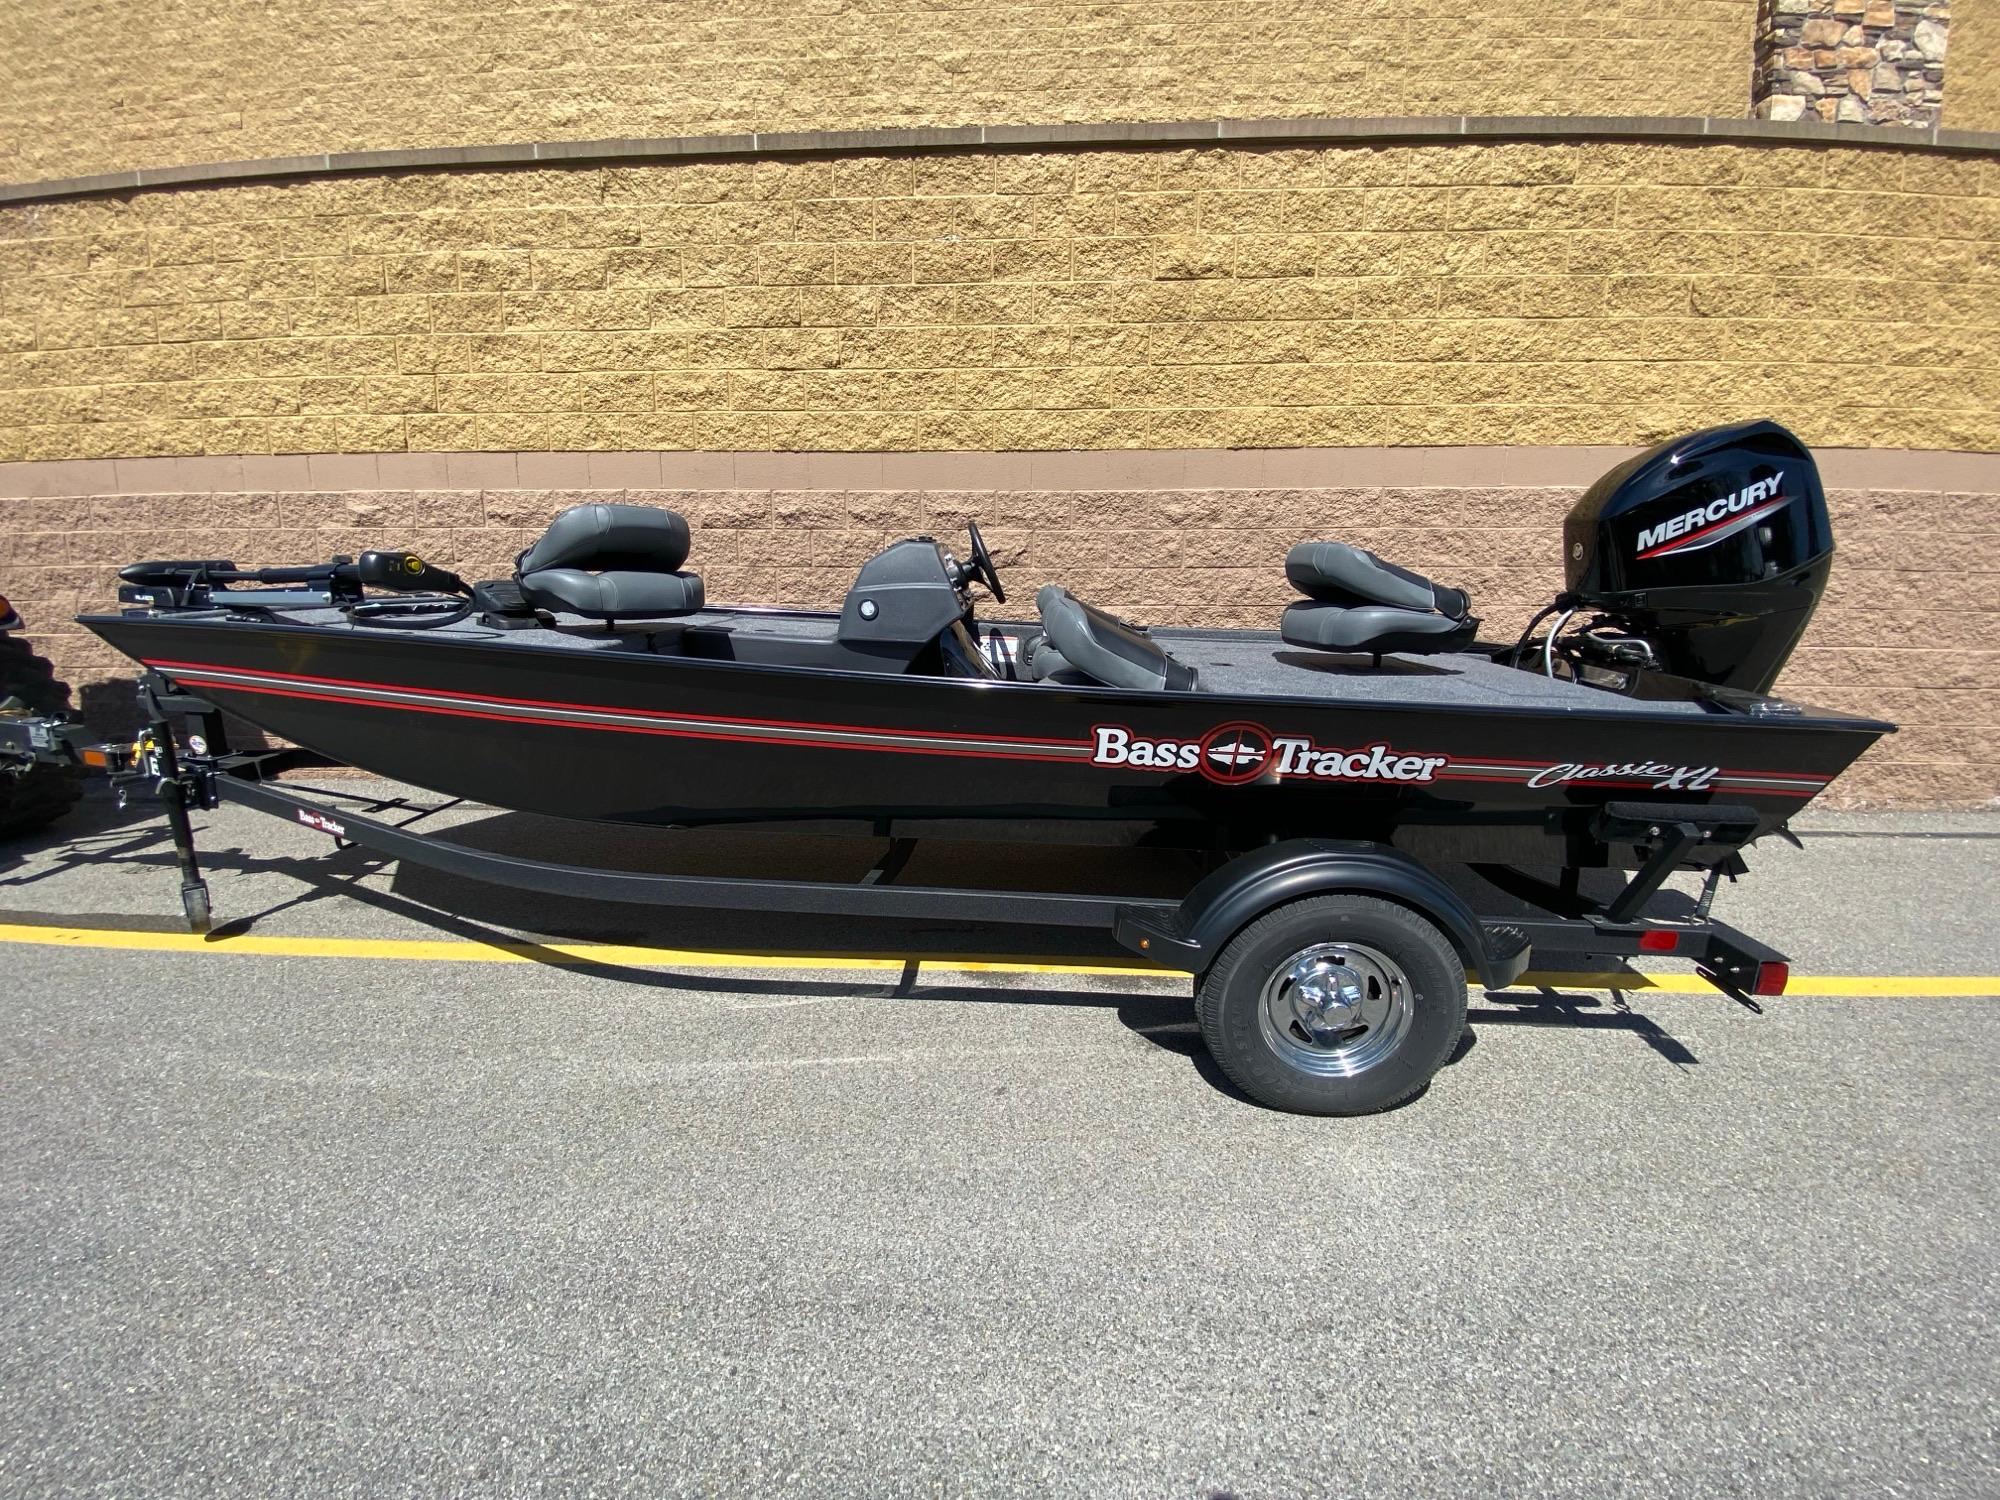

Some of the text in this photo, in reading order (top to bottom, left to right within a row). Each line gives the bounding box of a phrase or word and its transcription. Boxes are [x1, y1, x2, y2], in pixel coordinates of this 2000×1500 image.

[1636, 471, 1785, 552] MERCURY
[1093, 727, 1446, 780] Bass Tracker
[1527, 760, 1720, 791] Classic XL
